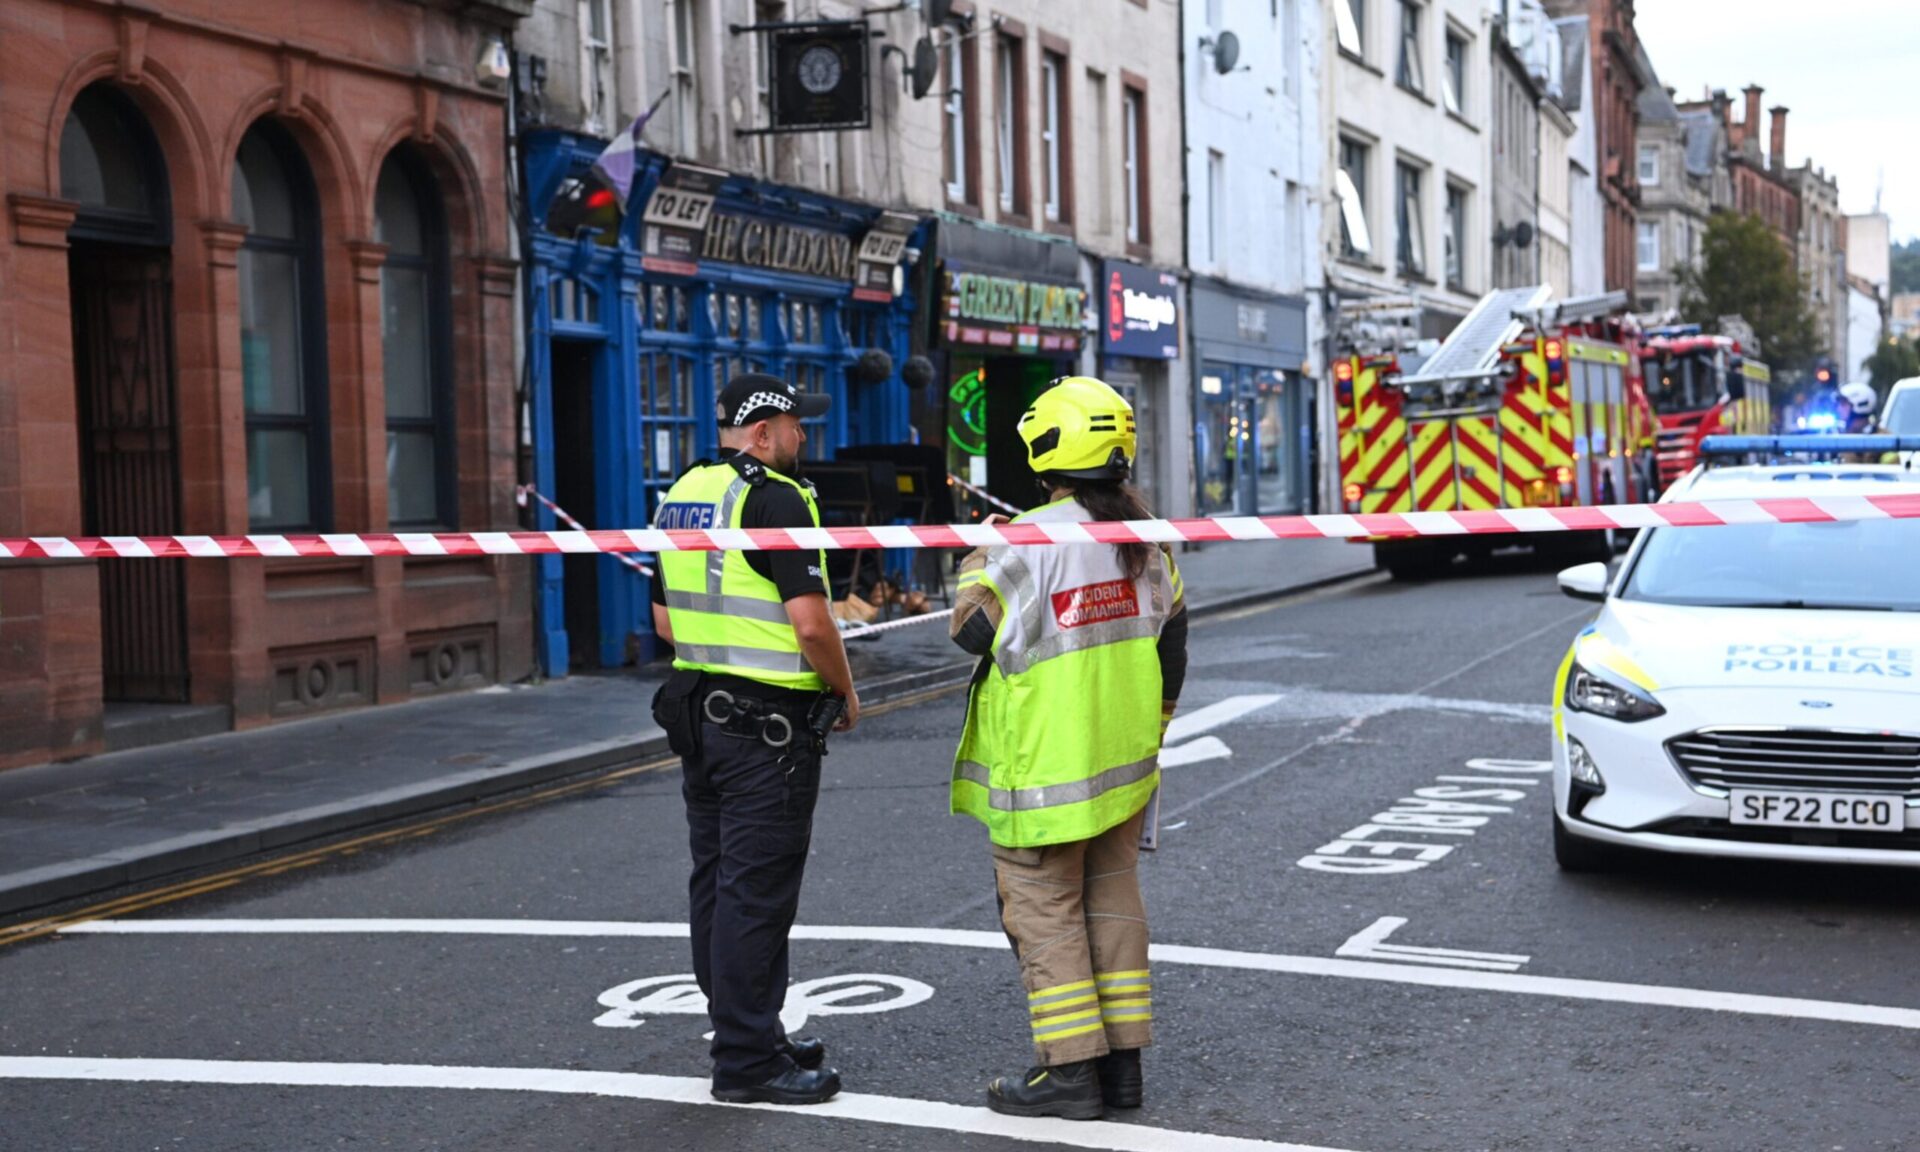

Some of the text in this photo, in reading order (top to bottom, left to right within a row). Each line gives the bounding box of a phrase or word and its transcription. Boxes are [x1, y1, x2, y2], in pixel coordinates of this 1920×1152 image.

[652, 194, 708, 222] TO LET
[702, 212, 741, 260] HE
[864, 235, 902, 257] TO LET
[960, 272, 1027, 325] GREEN
[1028, 283, 1083, 330] PLACE
[659, 505, 712, 529] POLICE
[1070, 583, 1123, 605] INCIDENT
[1059, 599, 1135, 625] COMMANDER
[1726, 644, 1913, 661] POLICE
[1724, 659, 1913, 677] POILEAS
[1297, 758, 1553, 873] DISABLED
[1743, 794, 1891, 826] SF22 CCO
